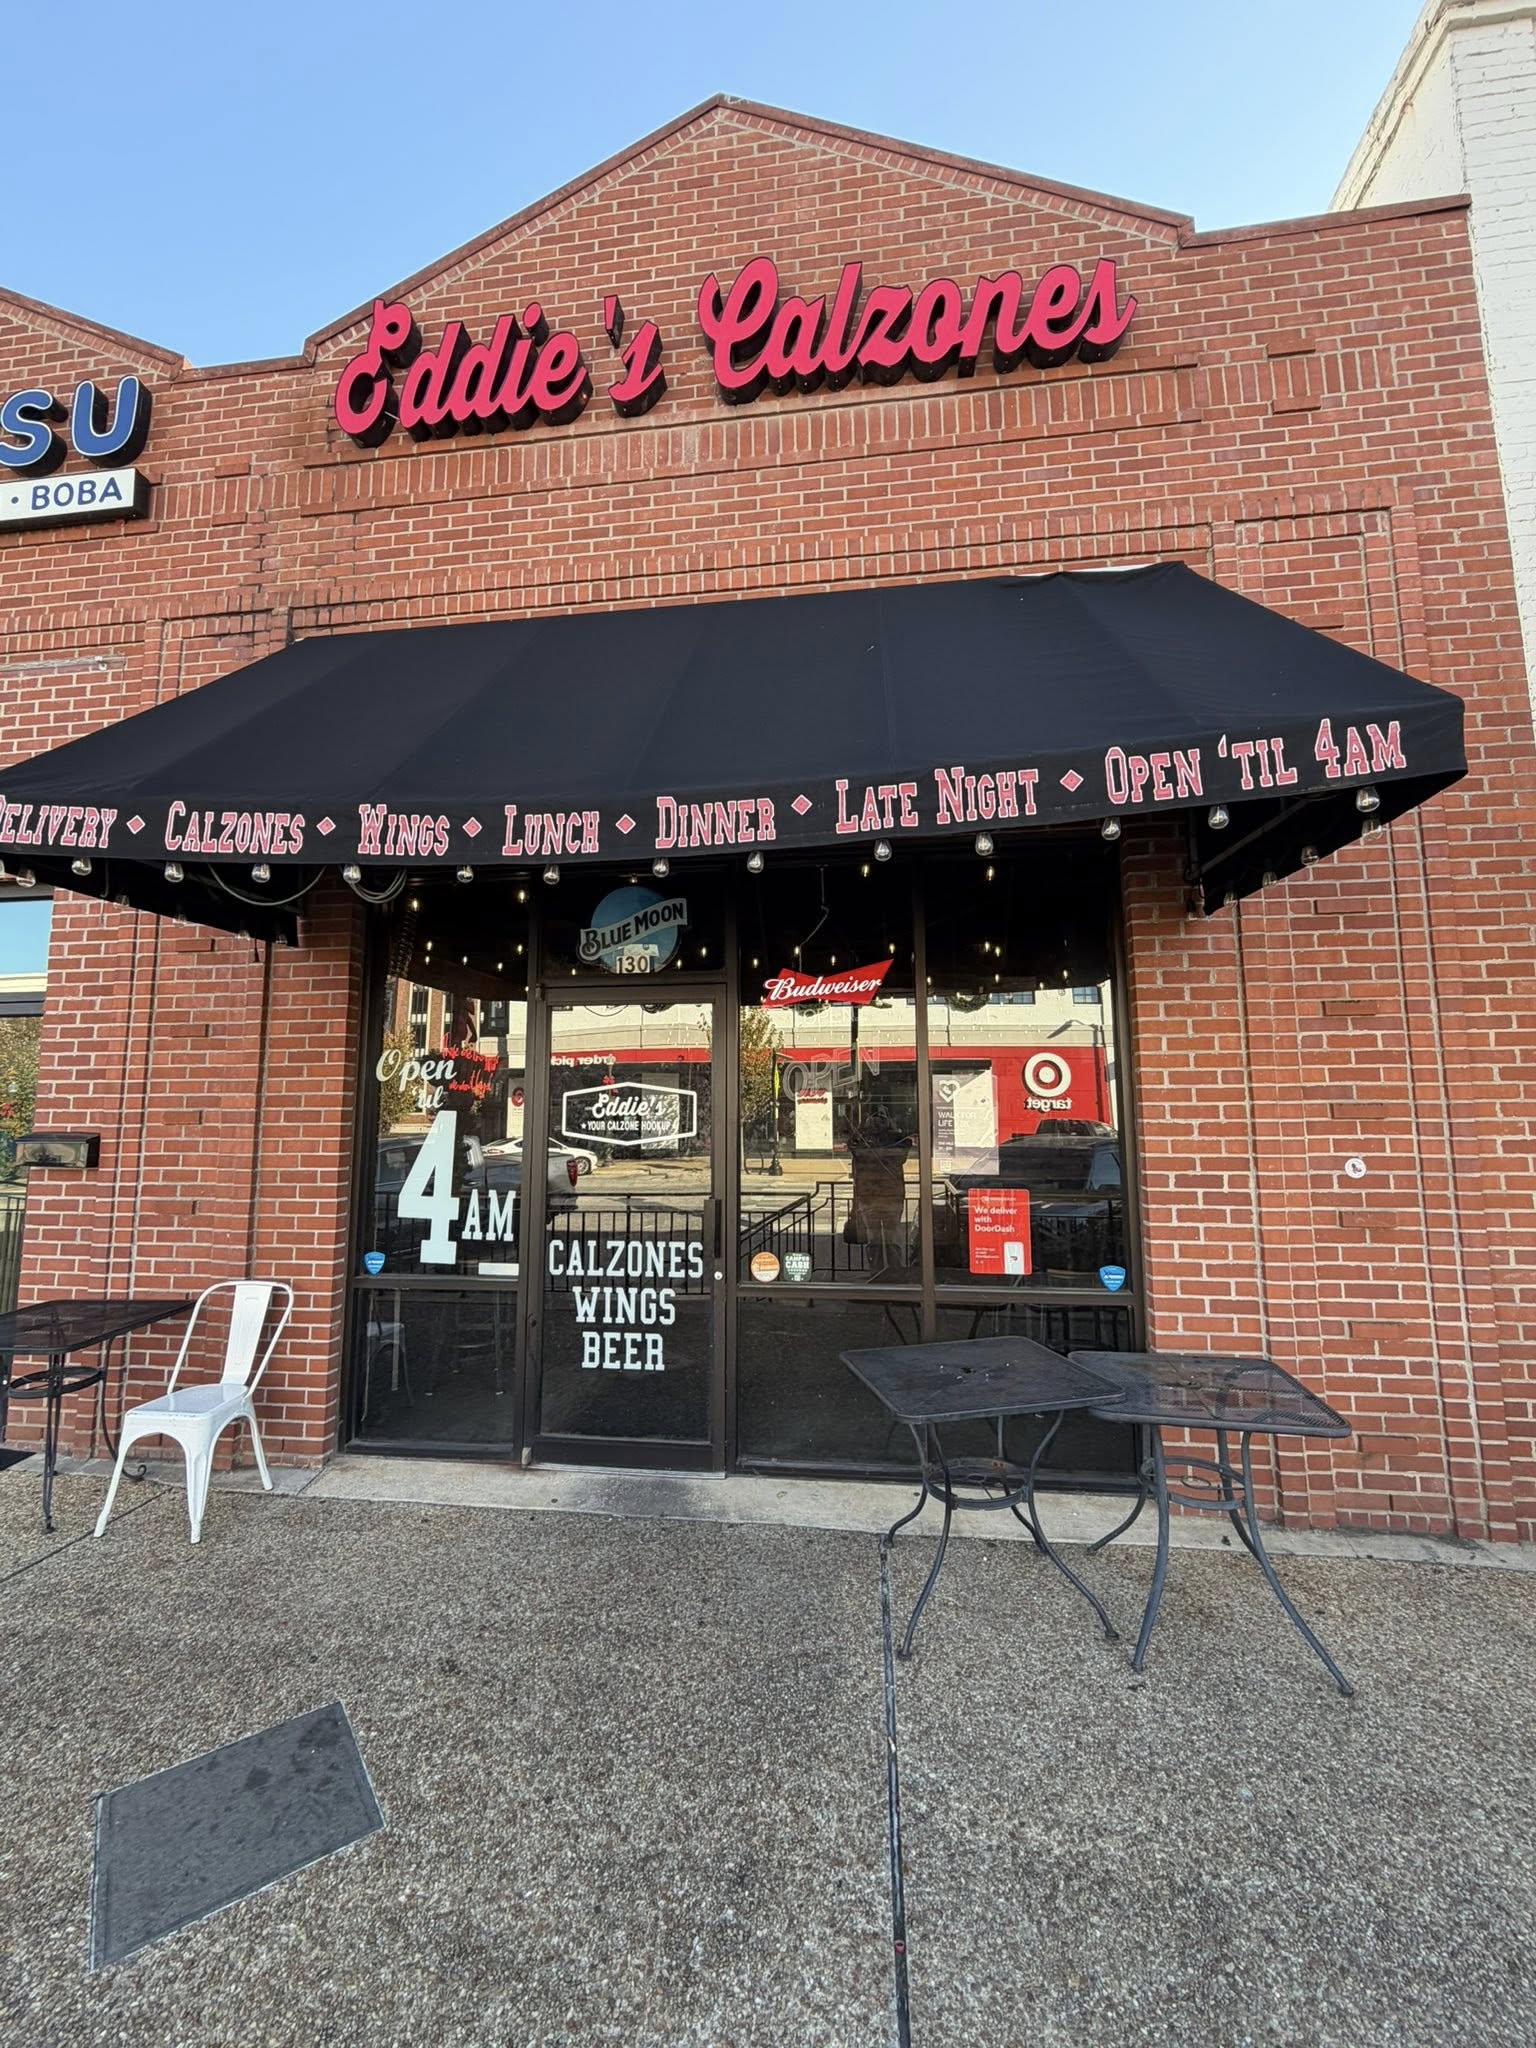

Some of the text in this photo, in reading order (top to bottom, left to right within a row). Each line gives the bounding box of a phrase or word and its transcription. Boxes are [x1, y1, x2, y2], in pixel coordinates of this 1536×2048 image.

[335, 257, 1138, 436] Eddie's Calzones
[31, 476, 123, 511] BOBA
[581, 902, 684, 957] BLUE MOON
[764, 976, 882, 1001] Budweiser
[376, 1049, 457, 1091] Open
[783, 1038, 880, 1101] OPEN
[591, 1093, 666, 1118] Eddie's
[588, 1120, 672, 1131] YOUR CALZONE HOOKUP
[974, 1206, 1017, 1215] We deliver
[974, 1215, 992, 1223] with
[974, 1224, 1015, 1233] DoorDash
[549, 1240, 704, 1278] CALZONES
[785, 1261, 810, 1269] CASH
[572, 1286, 676, 1325] WINGS
[581, 1331, 665, 1371] BEER
